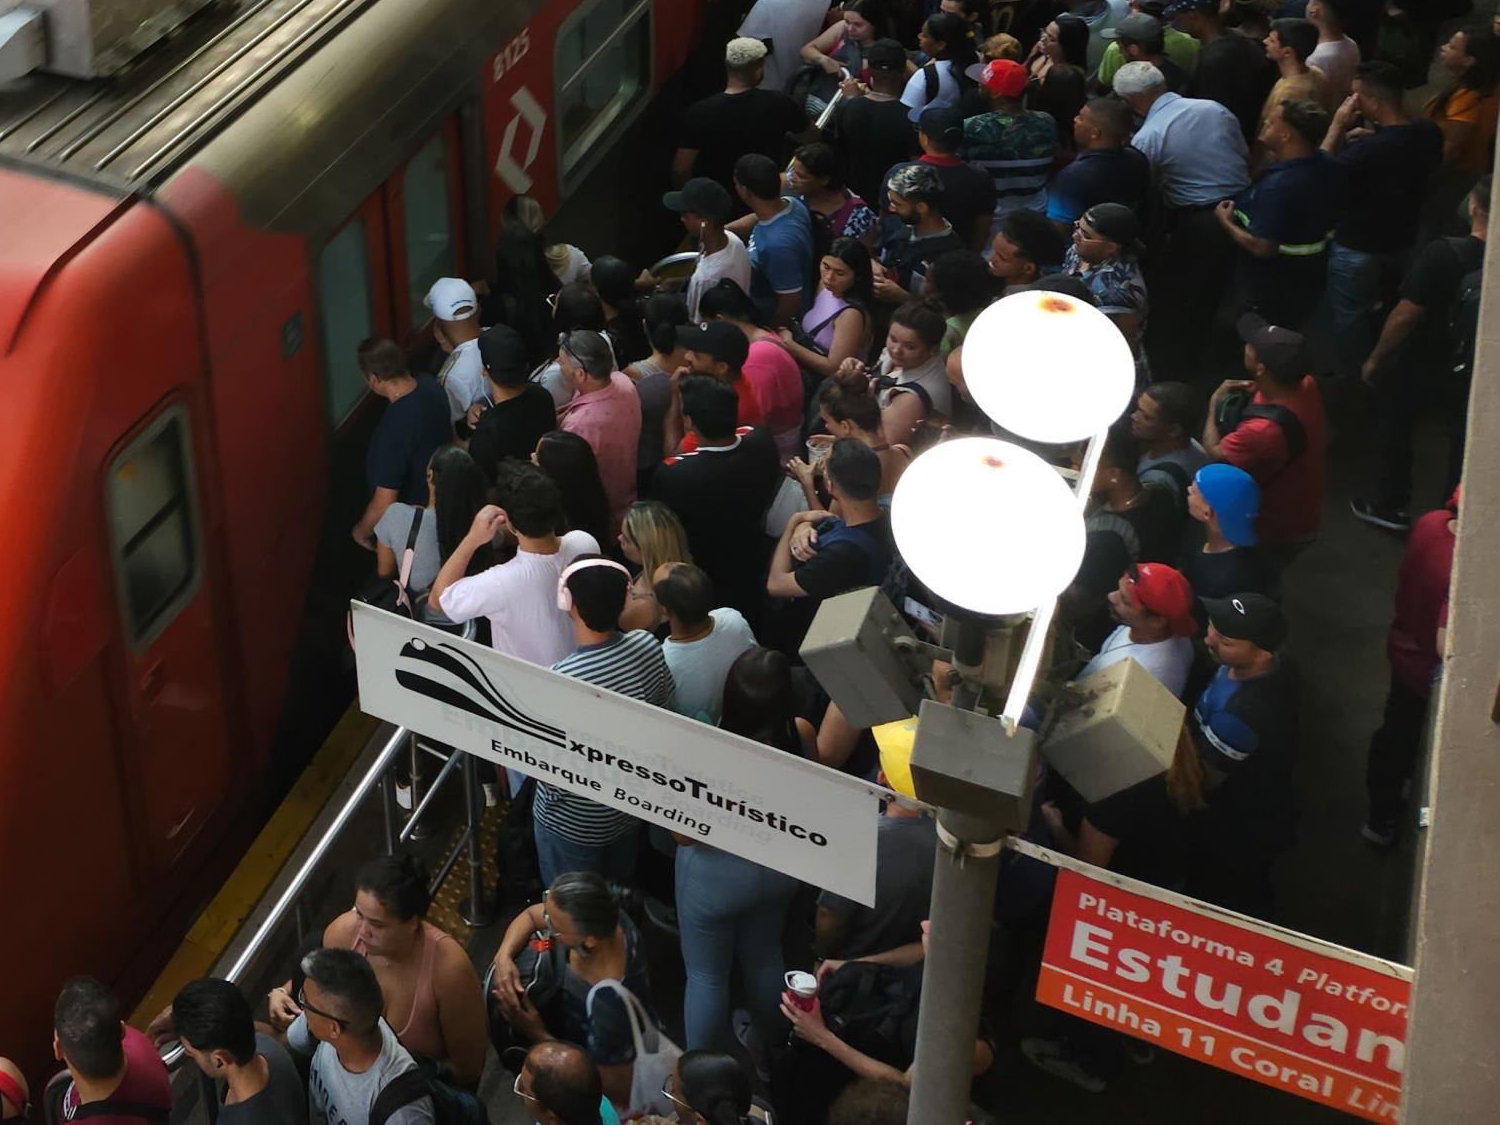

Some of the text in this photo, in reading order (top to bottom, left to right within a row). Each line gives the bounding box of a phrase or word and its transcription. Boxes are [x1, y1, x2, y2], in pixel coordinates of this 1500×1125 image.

[490, 738, 712, 837] Embarque Boarding
[1078, 891, 1409, 1019] Plataforma 4 Platfor
[1062, 983, 1161, 1038] Linha
[1175, 1026, 1216, 1057] 11
[1230, 1046, 1333, 1098] Coral
